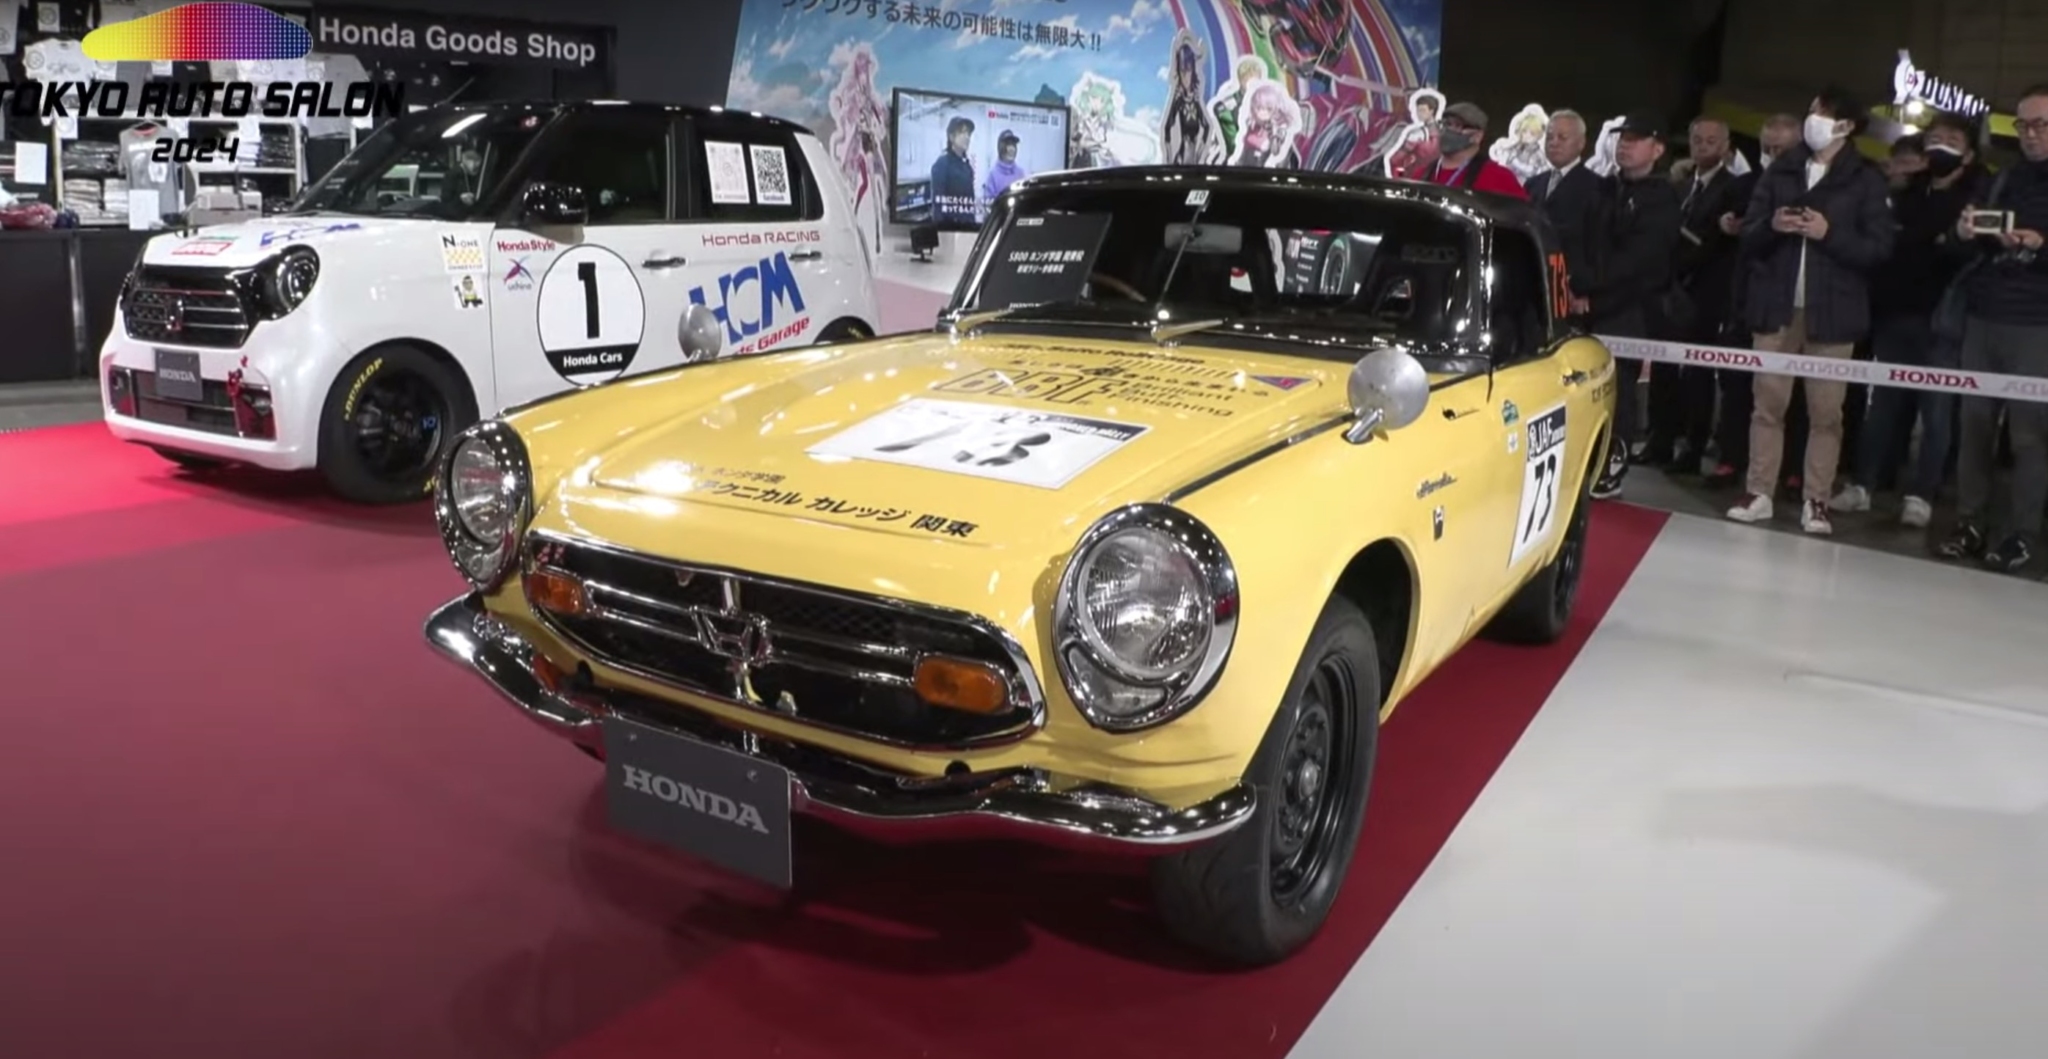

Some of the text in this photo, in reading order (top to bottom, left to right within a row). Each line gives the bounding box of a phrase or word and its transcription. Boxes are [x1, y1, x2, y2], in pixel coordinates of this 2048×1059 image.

[319, 17, 596, 67] Honda Goods Shop
[702, 230, 820, 246] Honda RACING
[578, 262, 600, 340] 1
[689, 251, 805, 344] HCM
[1549, 253, 1567, 318] 73
[757, 317, 811, 351] Garage
[159, 368, 197, 382] HONDA
[563, 352, 623, 368] Honda Cars
[1684, 349, 1763, 367] HONDA
[1888, 369, 1979, 389] HONDA
[345, 358, 383, 414] DUNLOP
[1533, 417, 1553, 455] JAF
[806, 496, 911, 522] カレッジ
[911, 514, 978, 538] 関東
[1522, 453, 1557, 544] 73
[622, 764, 770, 835] HONDA
